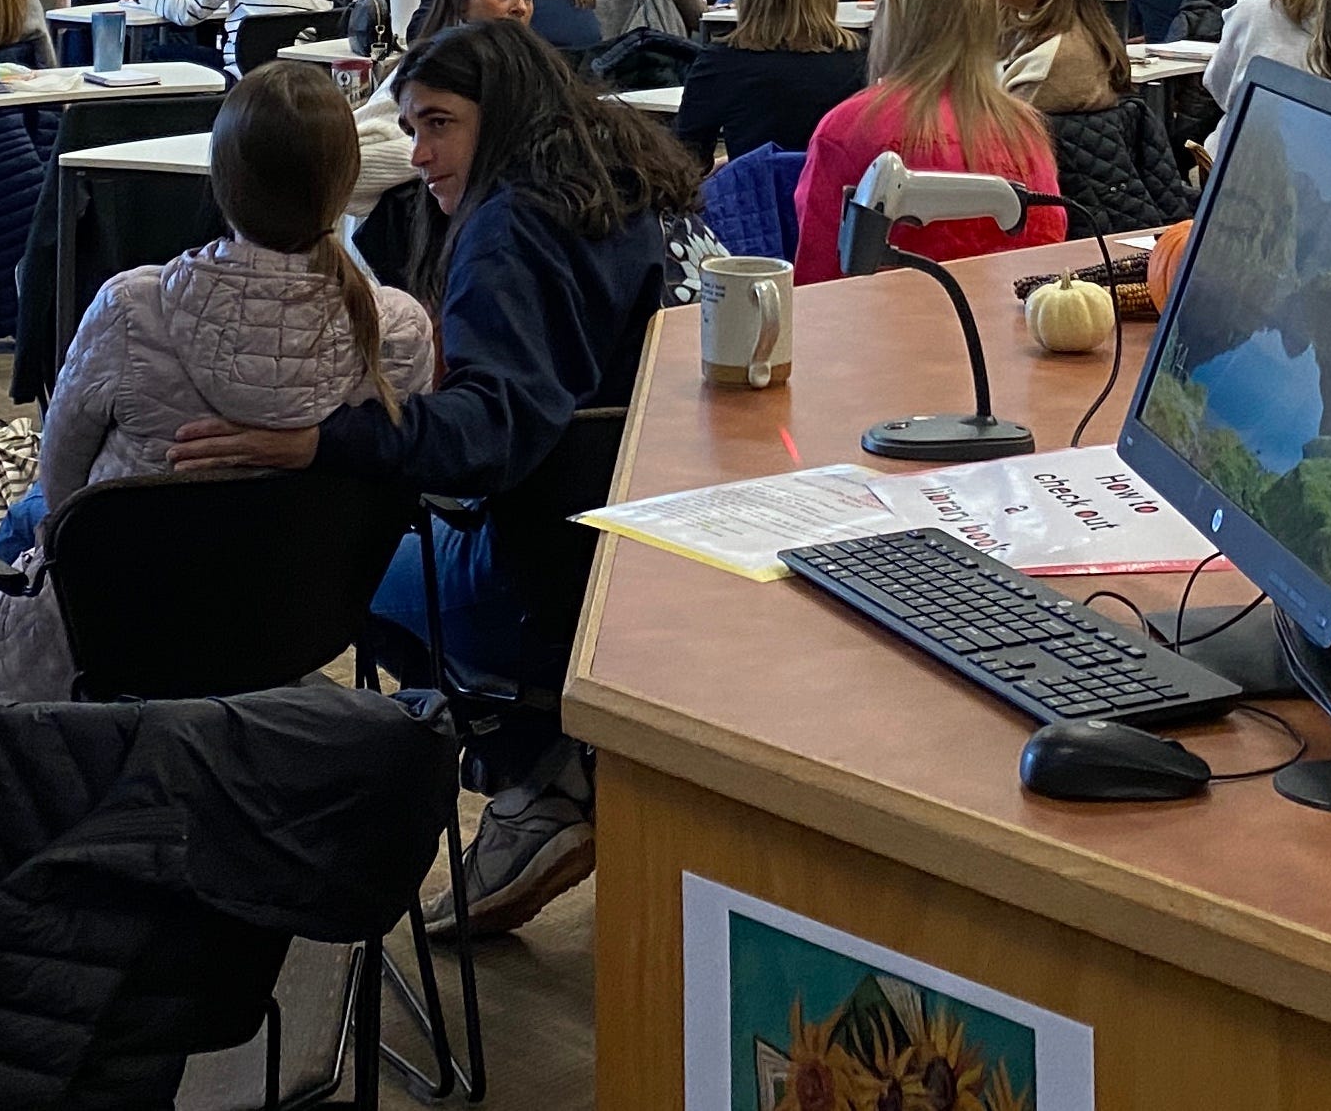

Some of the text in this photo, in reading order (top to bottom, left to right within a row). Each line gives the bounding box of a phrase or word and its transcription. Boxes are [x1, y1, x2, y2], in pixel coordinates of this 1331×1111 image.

[1004, 504, 1029, 515] a
[1032, 472, 1121, 532] check out
[1094, 473, 1160, 514] How to
[920, 485, 975, 523] library
[958, 522, 1011, 554] book
